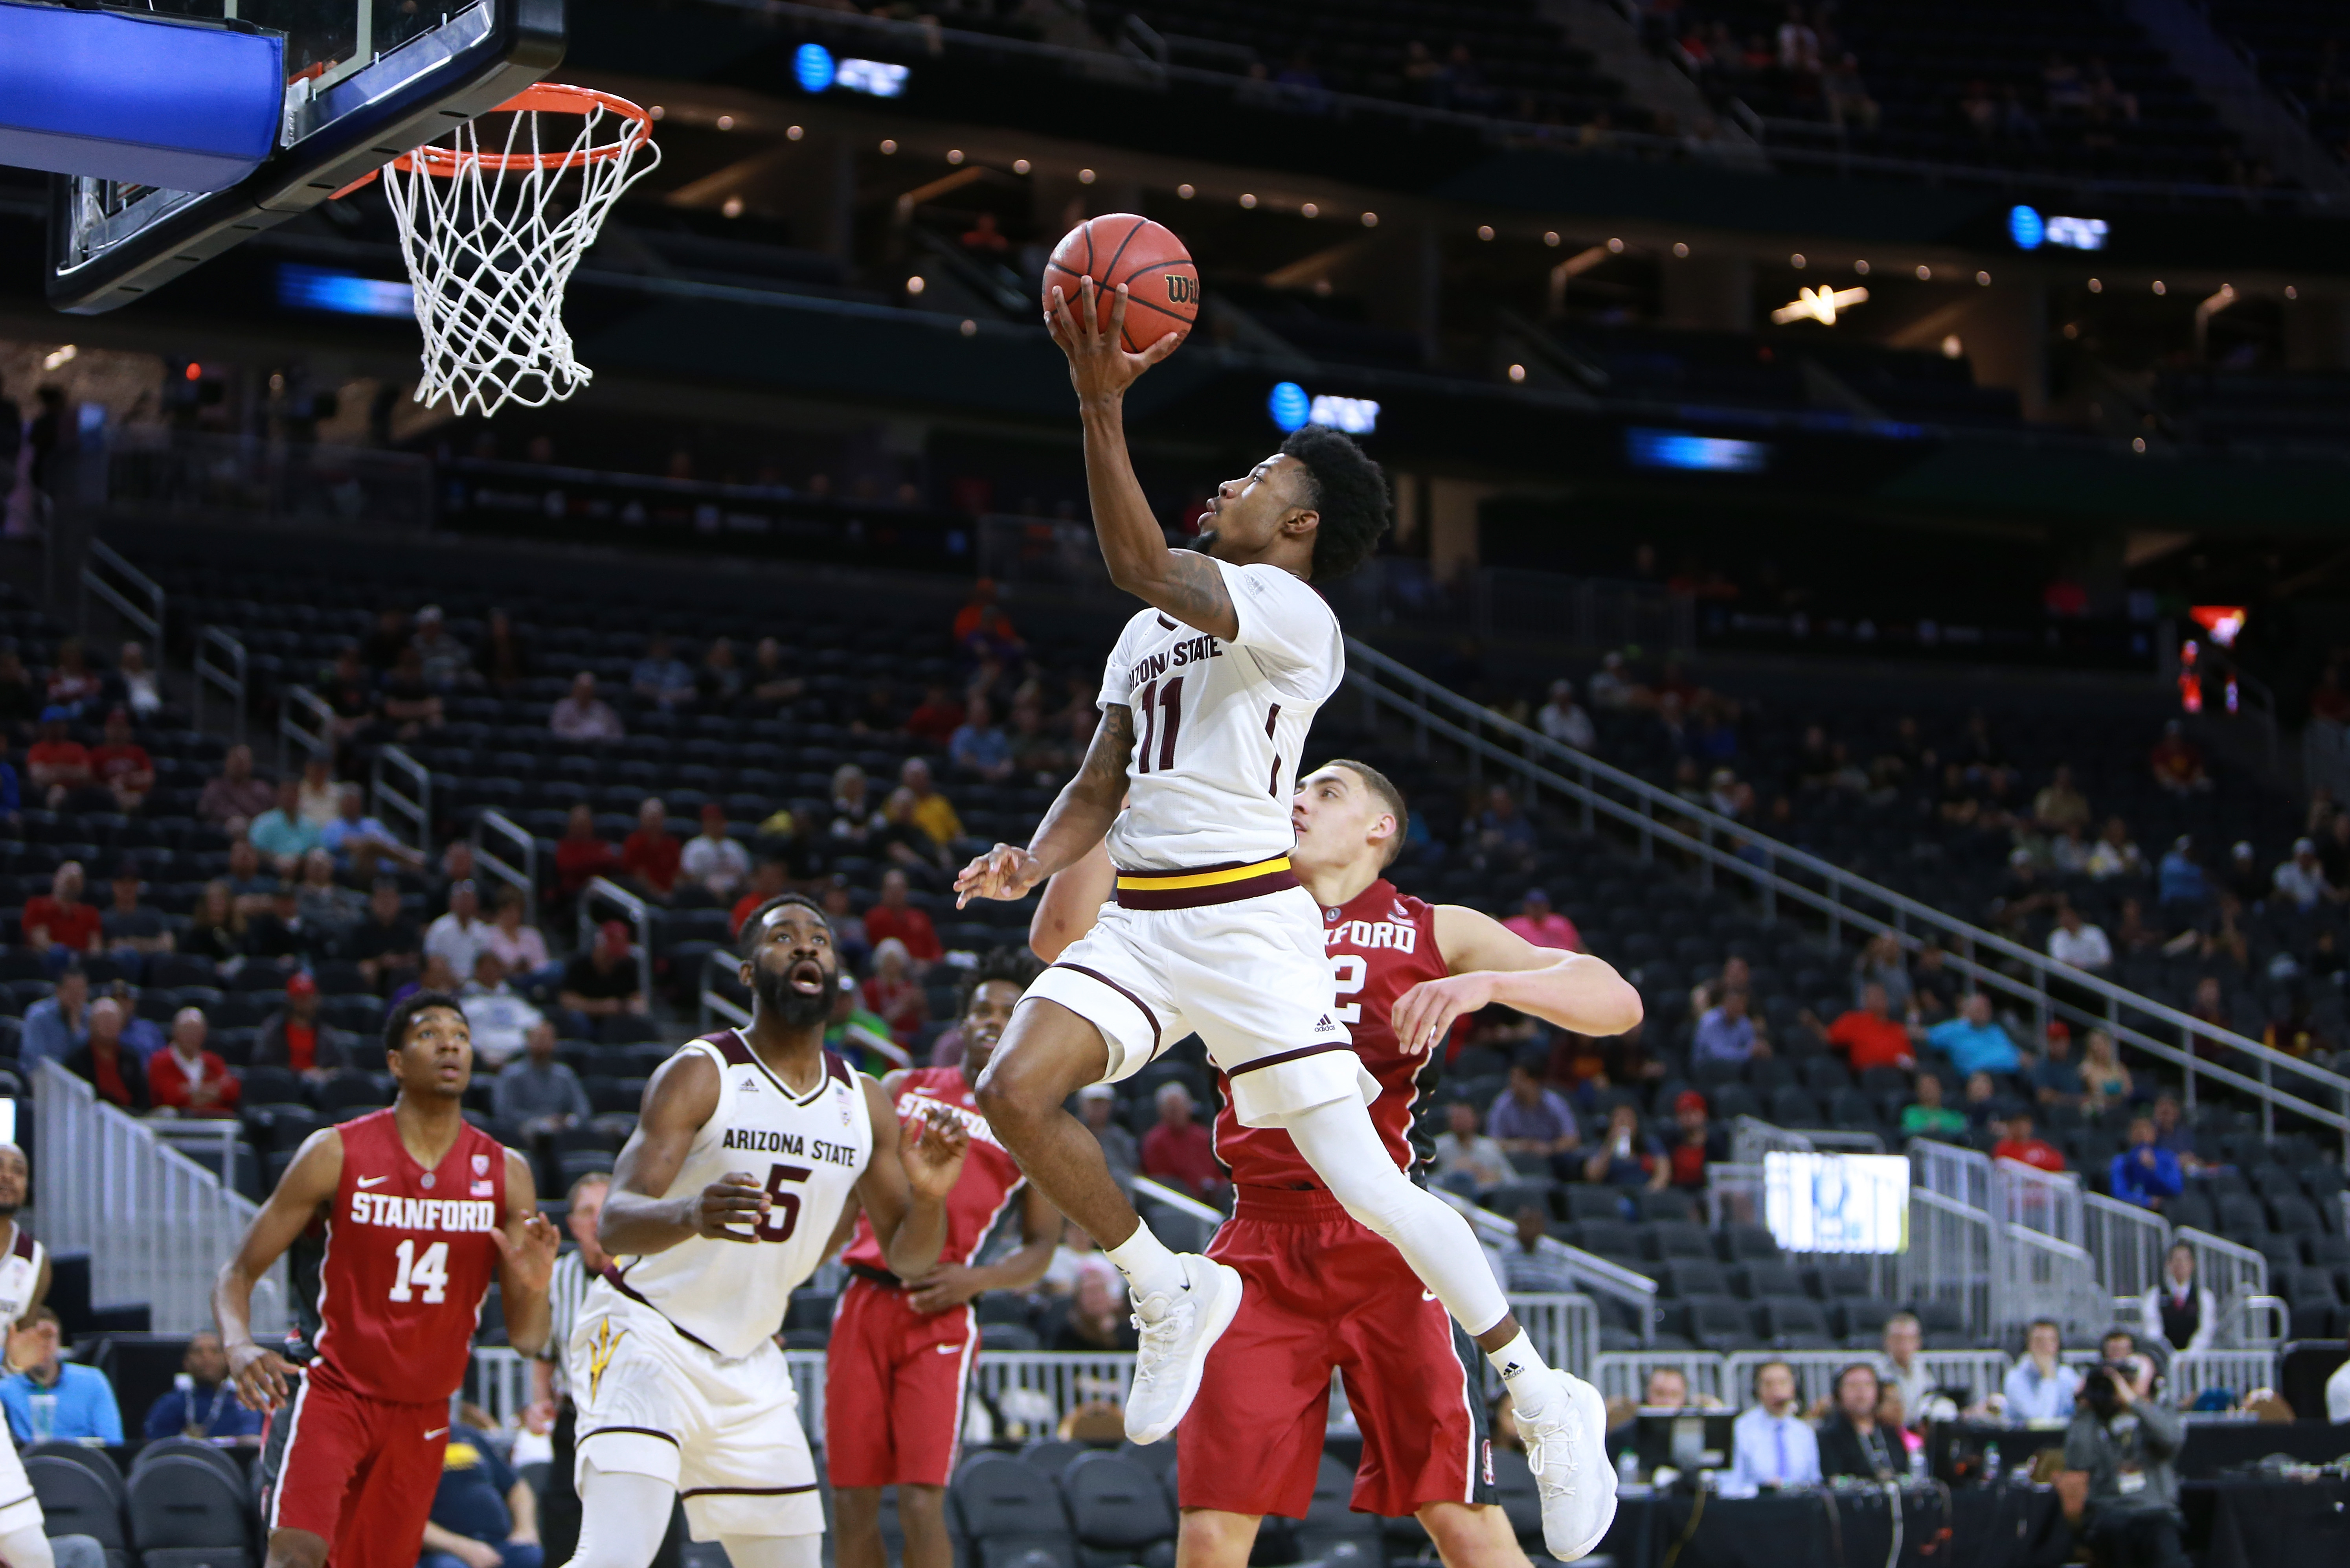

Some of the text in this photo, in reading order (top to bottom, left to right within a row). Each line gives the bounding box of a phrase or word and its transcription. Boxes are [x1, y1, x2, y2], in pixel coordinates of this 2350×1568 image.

[1173, 634, 1223, 666] STATE
[1139, 676, 1184, 774] 11
[1314, 1024, 1336, 1032] adidas
[722, 1128, 856, 1167] ARIZONA STATE
[351, 1191, 495, 1233] STANFORD
[754, 1162, 813, 1243] 5
[388, 1239, 449, 1304] 14
